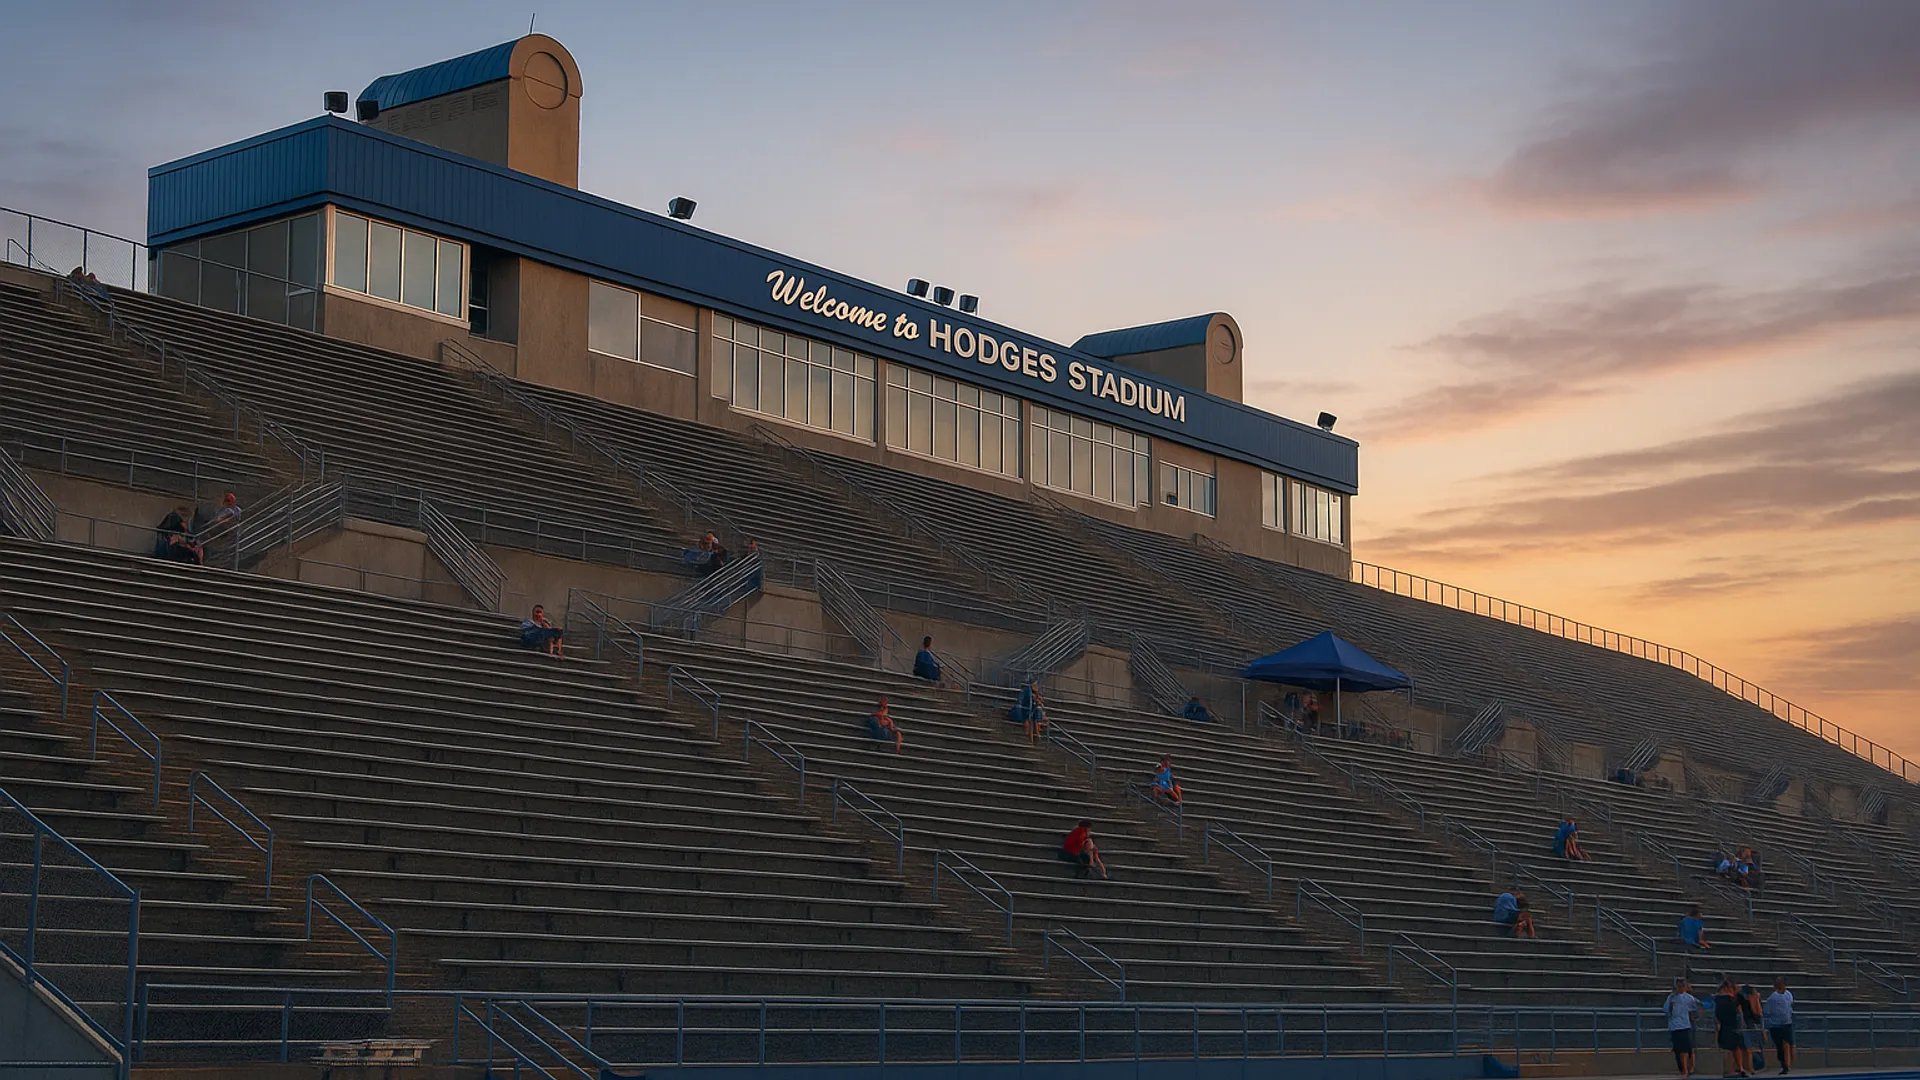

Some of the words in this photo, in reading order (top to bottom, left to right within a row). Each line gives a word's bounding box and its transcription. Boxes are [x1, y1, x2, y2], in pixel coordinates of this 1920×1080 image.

[766, 270, 887, 332] Welcome
[893, 312, 919, 340] to
[929, 318, 1058, 382] HODGES
[1068, 361, 1186, 423] STADIUM
